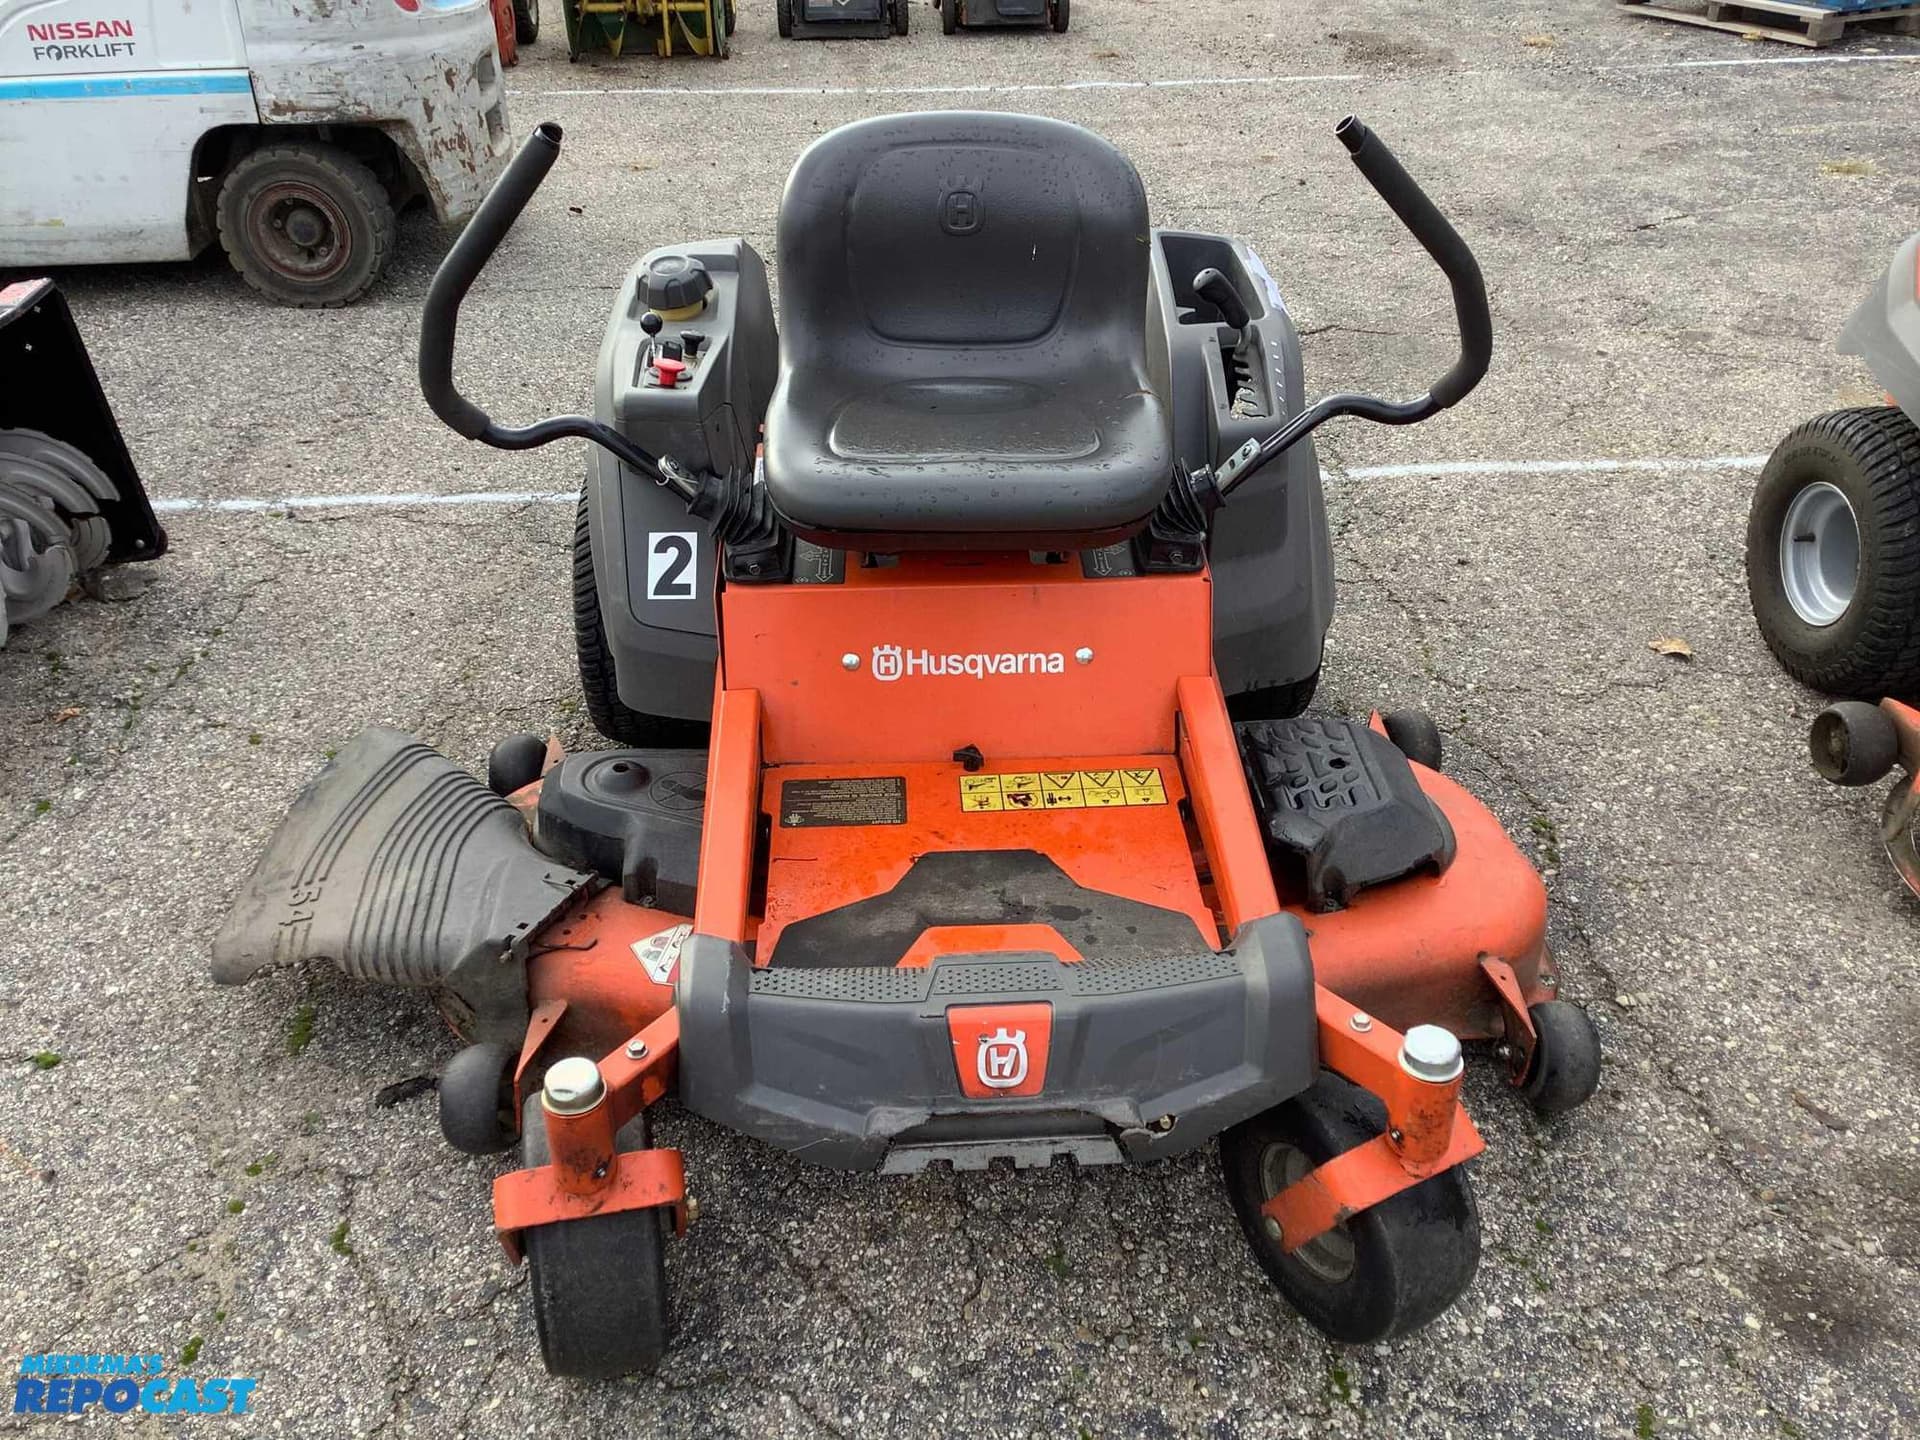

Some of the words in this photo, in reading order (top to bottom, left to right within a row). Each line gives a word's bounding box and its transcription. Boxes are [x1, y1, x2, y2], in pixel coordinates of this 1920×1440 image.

[27, 20, 133, 41] NISSAN
[33, 42, 136, 61] FORKLIFT
[653, 535, 692, 595] 2
[906, 649, 1065, 679] Husqvarna
